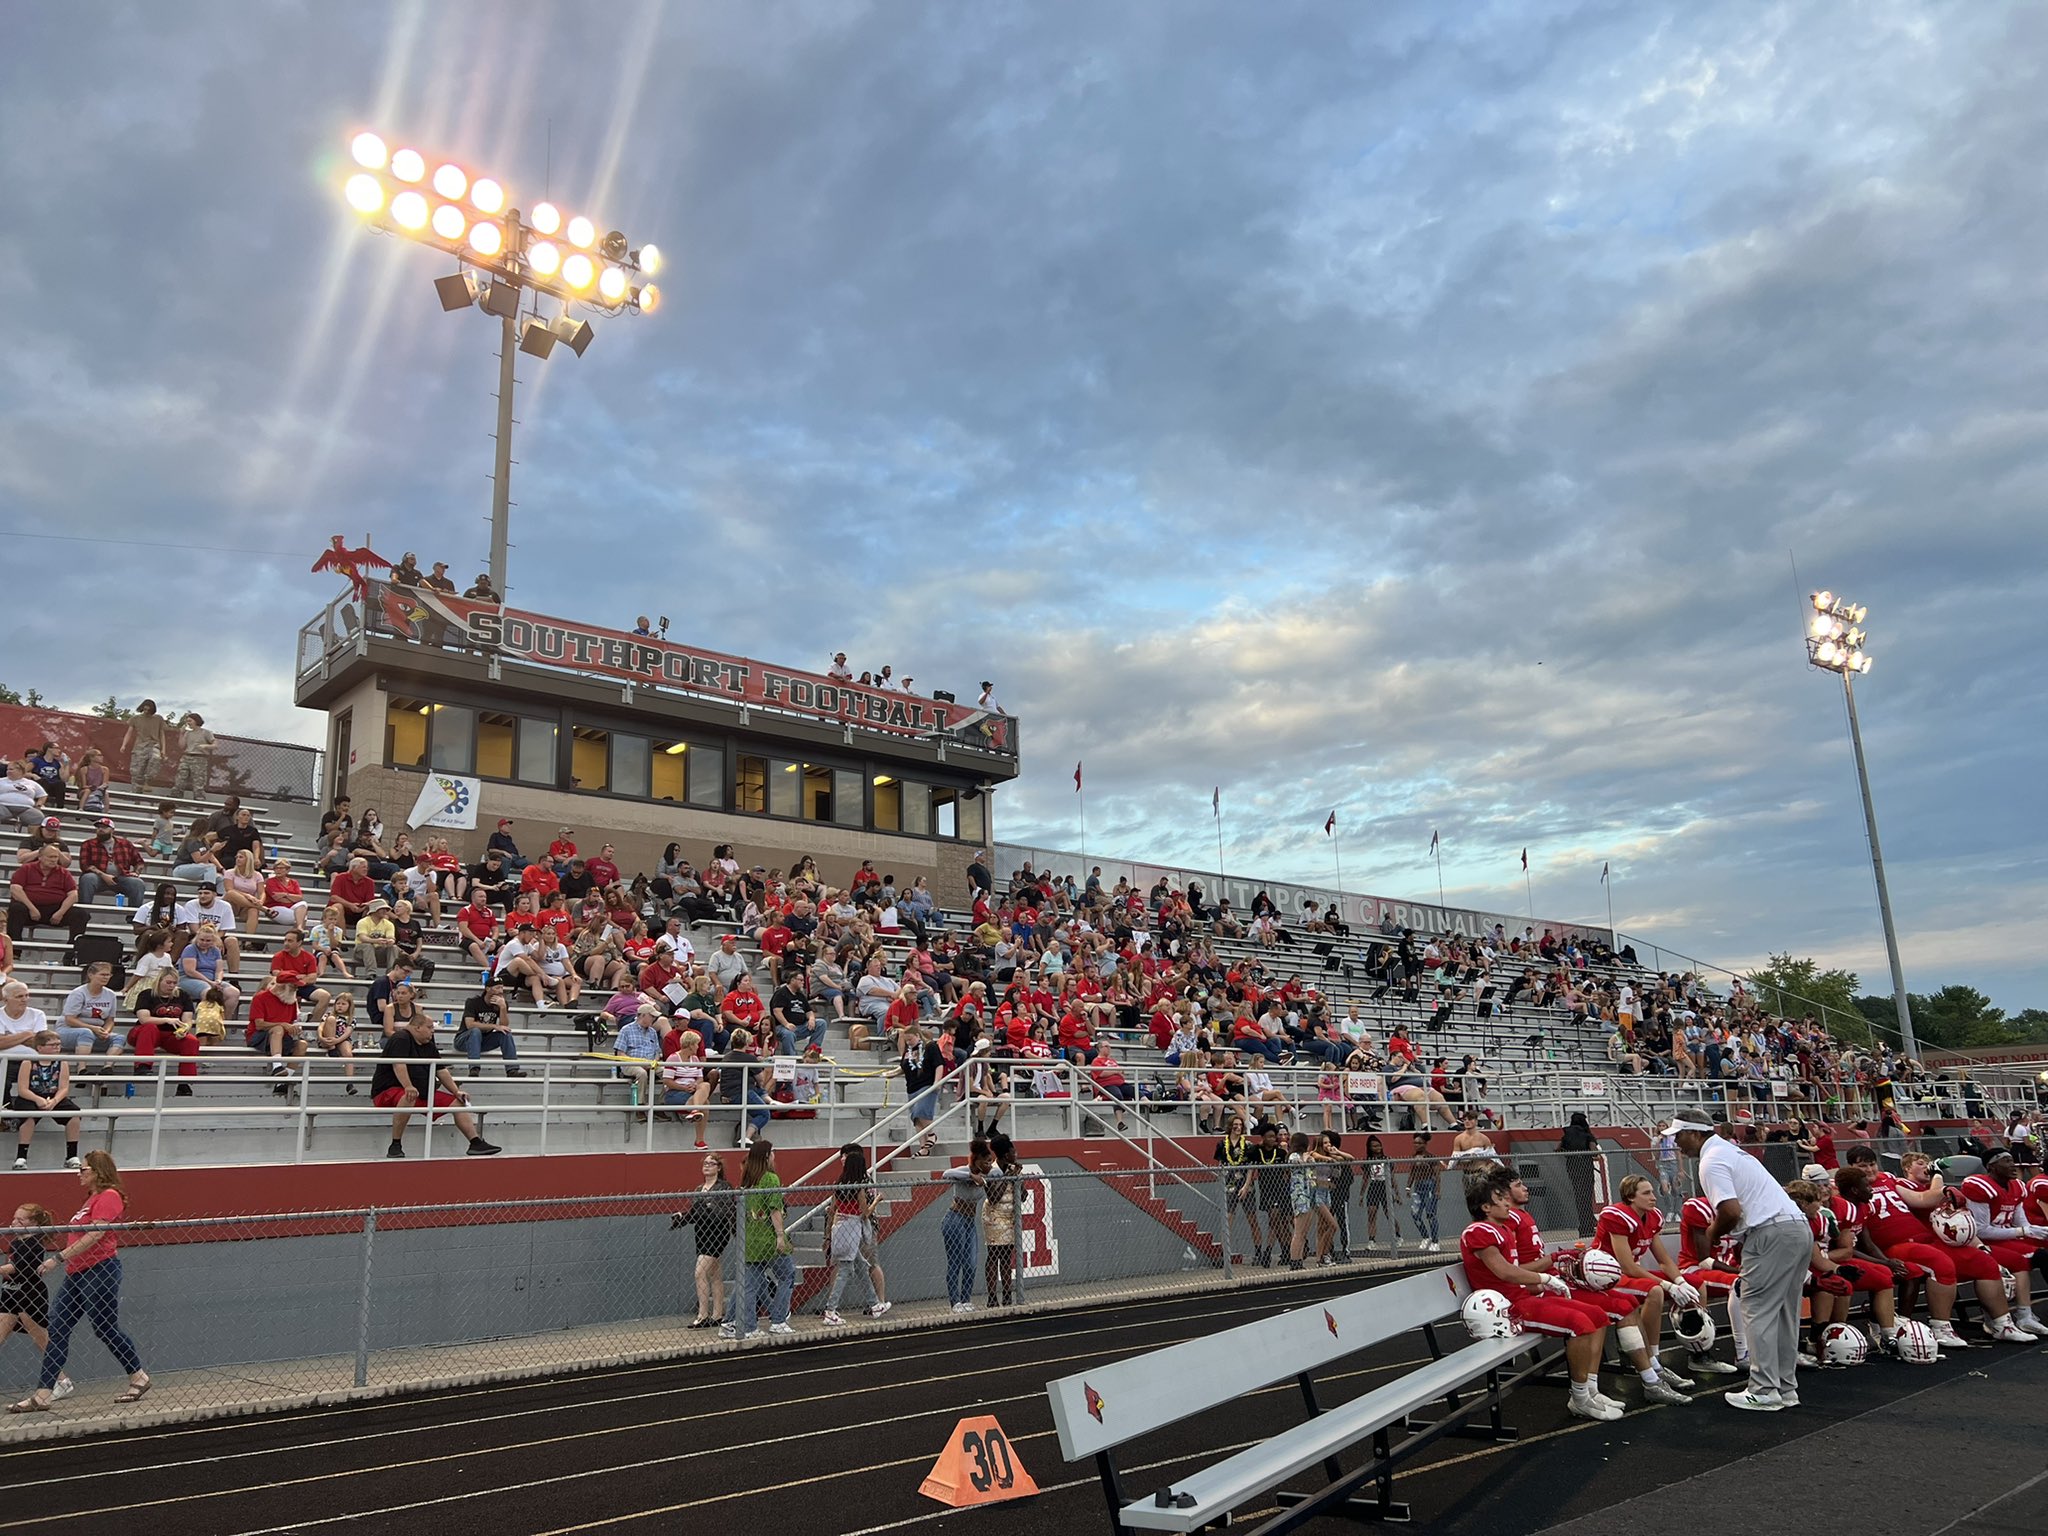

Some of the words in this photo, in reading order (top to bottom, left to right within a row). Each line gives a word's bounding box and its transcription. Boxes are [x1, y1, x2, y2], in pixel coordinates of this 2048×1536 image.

[466, 610, 749, 694] SOUTHPORT
[762, 671, 957, 737] FOOTBALL
[1870, 1191, 1910, 1219] 76
[1482, 1297, 1495, 1312] 3
[963, 1428, 1014, 1492] 30
